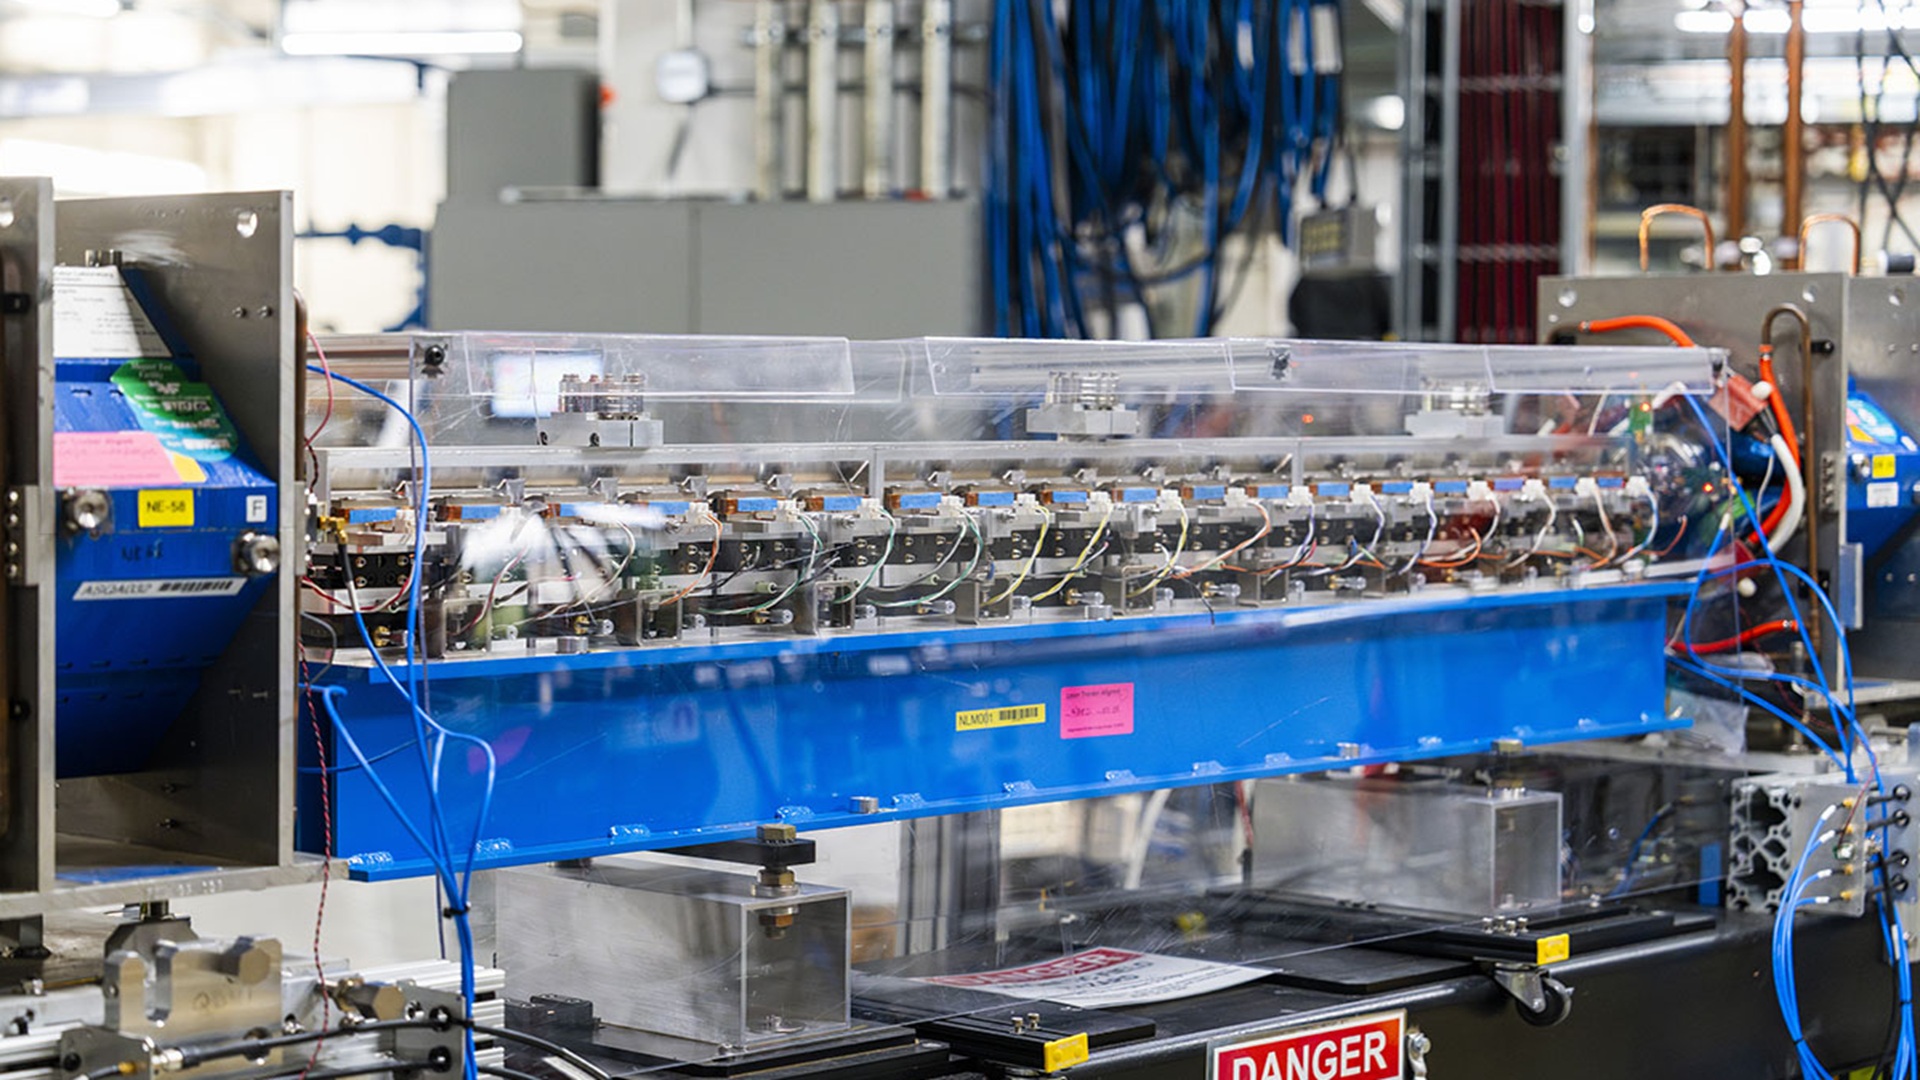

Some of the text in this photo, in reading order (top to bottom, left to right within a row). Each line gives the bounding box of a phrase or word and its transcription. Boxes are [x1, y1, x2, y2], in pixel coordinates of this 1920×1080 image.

[146, 500, 186, 513] NE-58
[252, 497, 264, 517] F
[1233, 1030, 1387, 1080] DANGER
